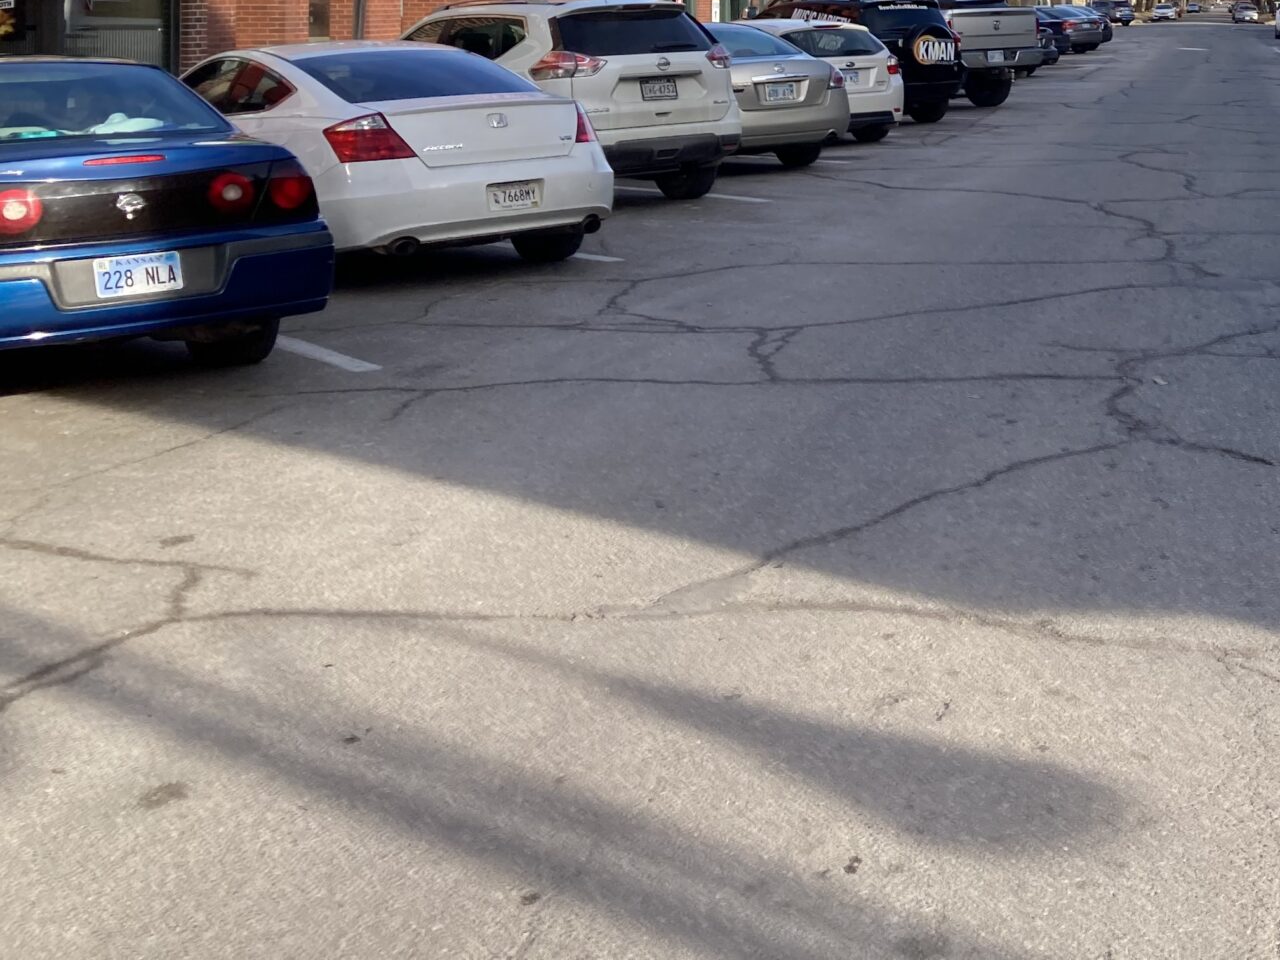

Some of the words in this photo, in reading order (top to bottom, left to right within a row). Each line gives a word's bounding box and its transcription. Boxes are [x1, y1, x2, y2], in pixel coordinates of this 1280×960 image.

[920, 41, 955, 61] KMAN
[423, 144, 463, 152] Accord
[502, 189, 536, 203] 7668MY
[115, 255, 163, 267] KANSAS
[102, 269, 134, 290] 228
[145, 264, 177, 286] NLA
